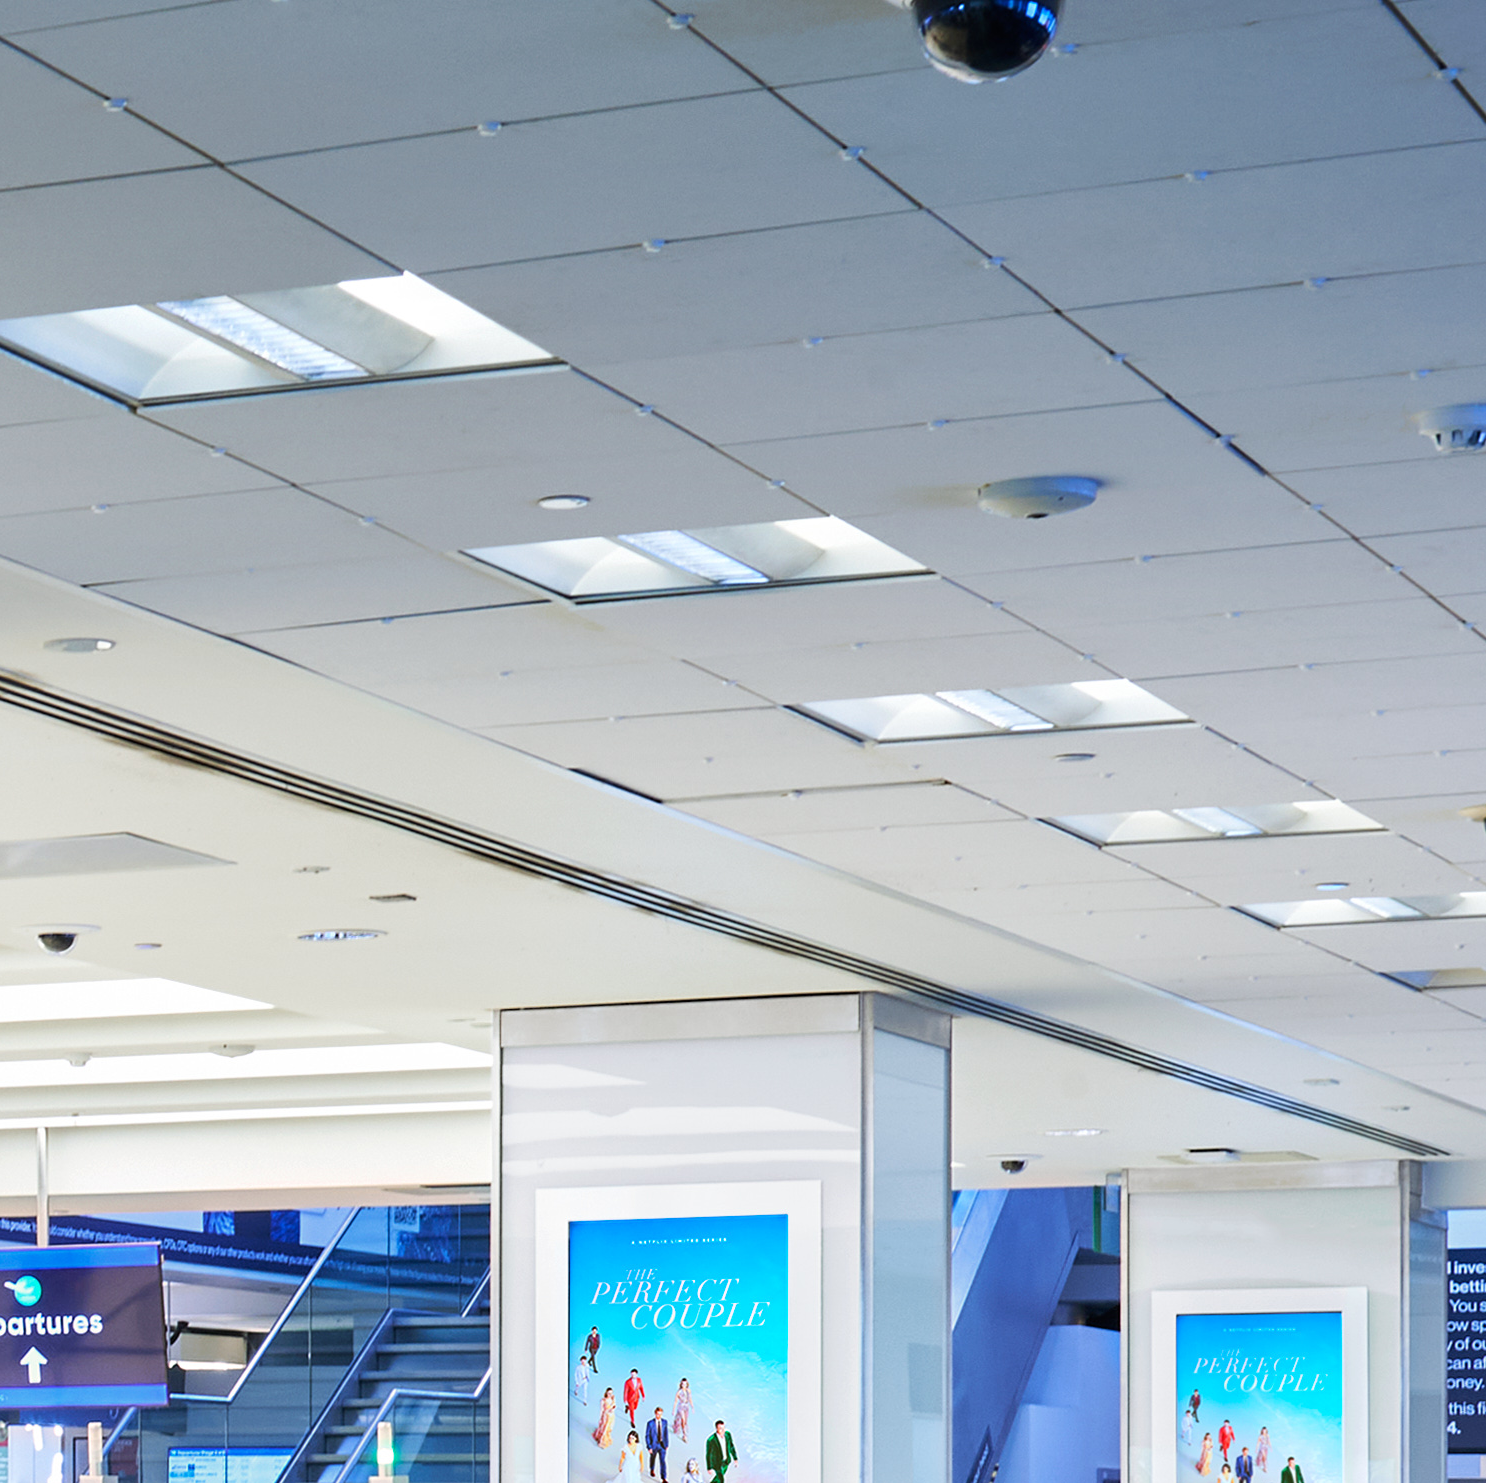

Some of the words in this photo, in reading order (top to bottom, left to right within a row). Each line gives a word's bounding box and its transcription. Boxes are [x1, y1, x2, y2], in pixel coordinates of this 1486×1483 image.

[625, 1268, 658, 1281] THE
[1453, 1260, 1486, 1275] inve
[590, 1278, 740, 1305] PERFECT
[1449, 1279, 1486, 1294] betti
[1449, 1298, 1478, 1313] You
[630, 1302, 771, 1331] COUPLE
[1193, 1356, 1306, 1374] PERFECT
[1223, 1373, 1328, 1393] COUPLE
[1448, 1401, 1475, 1416] this
